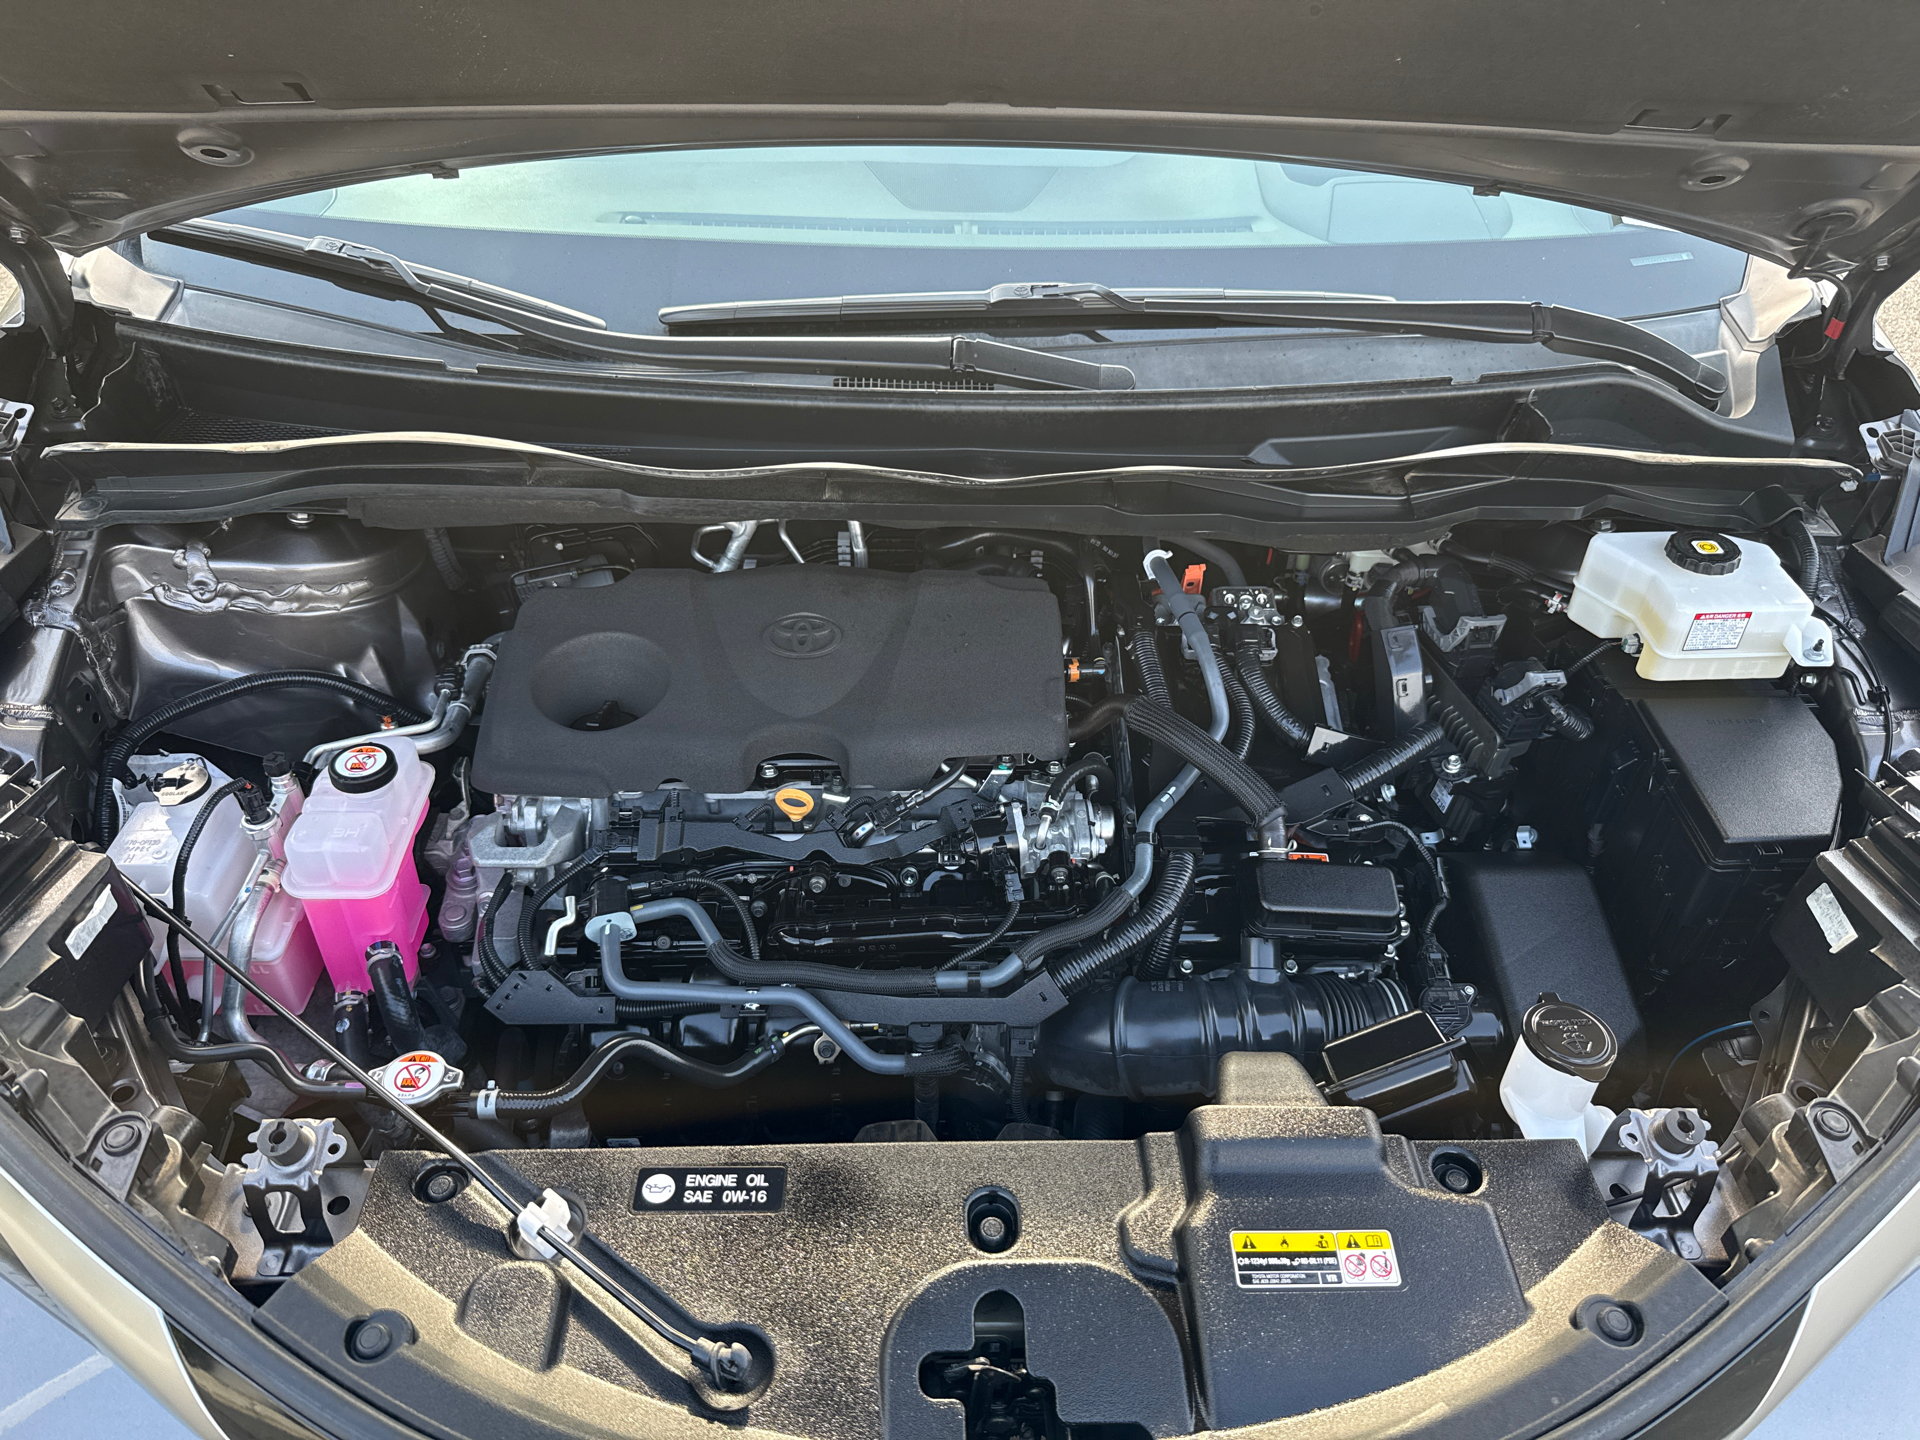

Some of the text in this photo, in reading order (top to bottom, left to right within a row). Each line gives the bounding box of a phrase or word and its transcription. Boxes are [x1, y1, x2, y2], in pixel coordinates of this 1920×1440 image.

[685, 1174, 769, 1187] ENGINE OIL
[683, 1190, 767, 1203] SAE 0W-16
